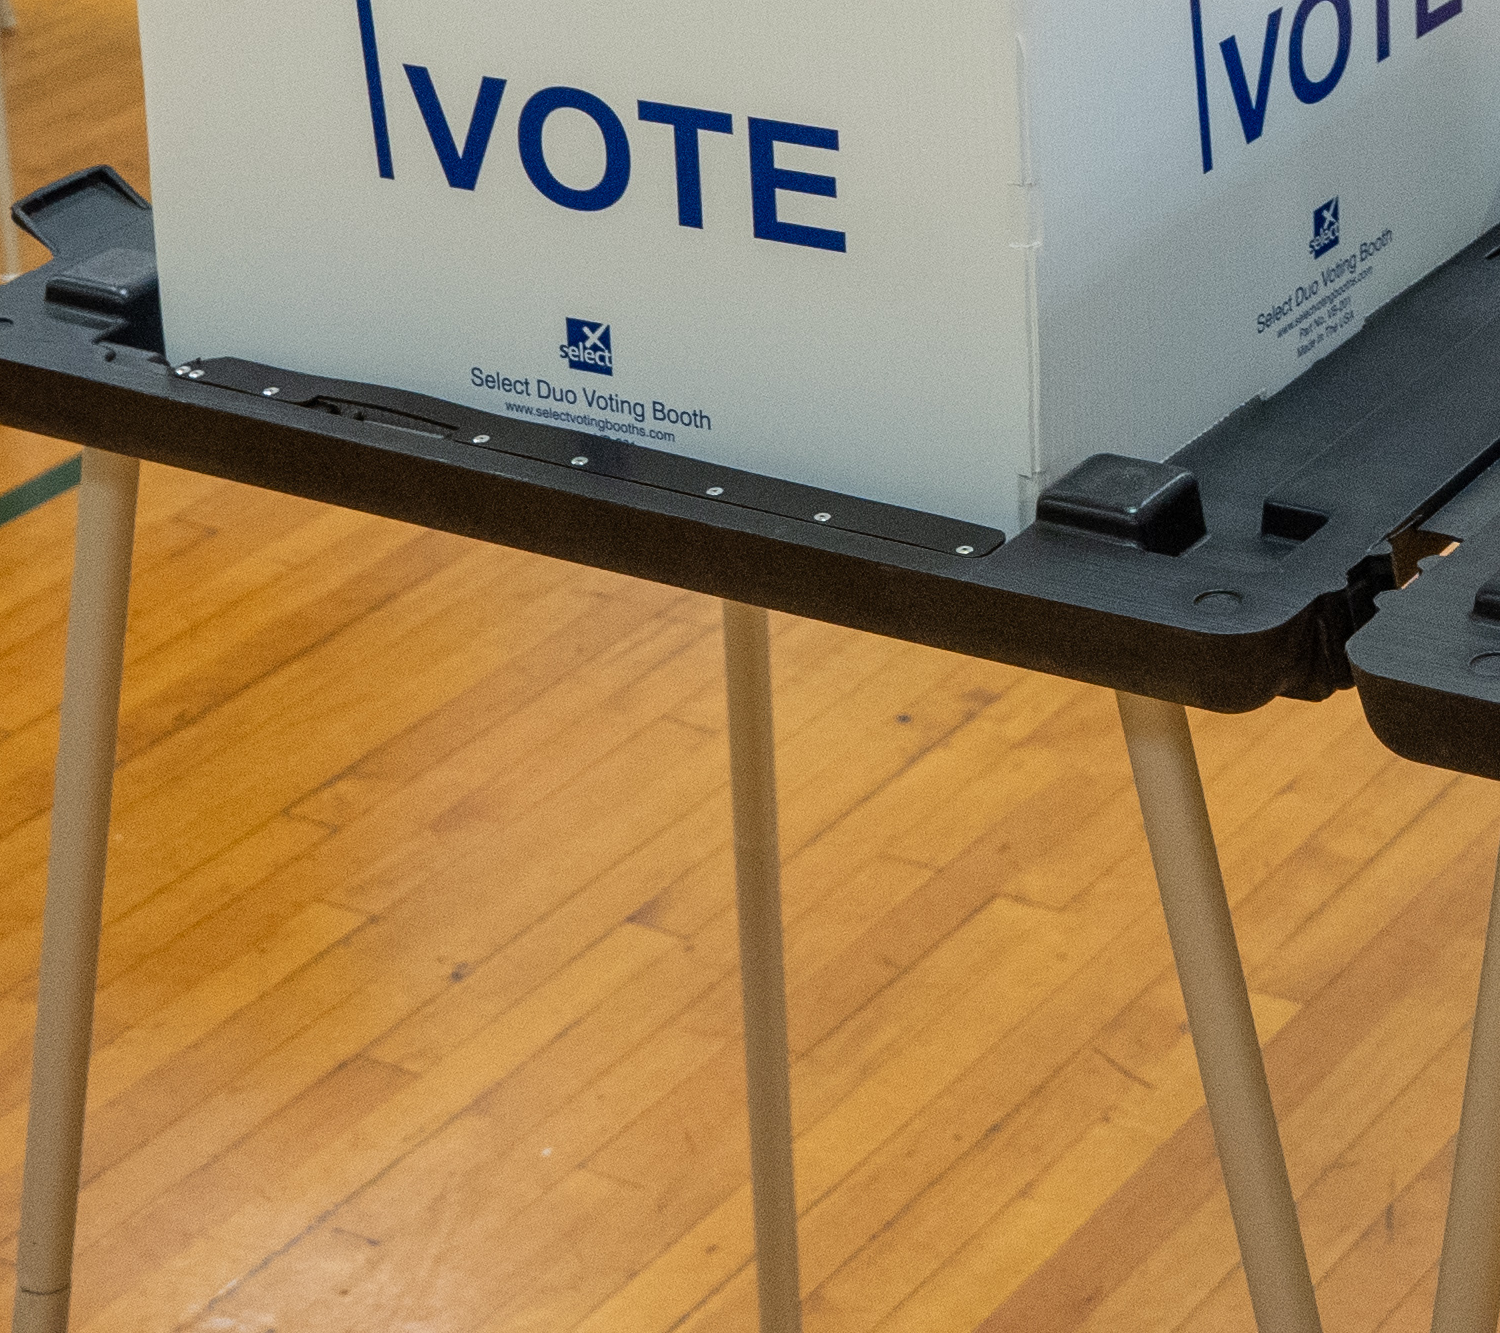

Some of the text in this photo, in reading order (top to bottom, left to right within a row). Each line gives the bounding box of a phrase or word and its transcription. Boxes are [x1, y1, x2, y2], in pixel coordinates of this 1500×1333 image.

[402, 63, 847, 253] VOTE
[1257, 295, 1293, 334] Select
[1360, 228, 1393, 262] Booth
[559, 341, 613, 369] select
[470, 366, 712, 431] Select Duo Voting Booth
[505, 400, 675, 442] www.selectvotingbooths.com
